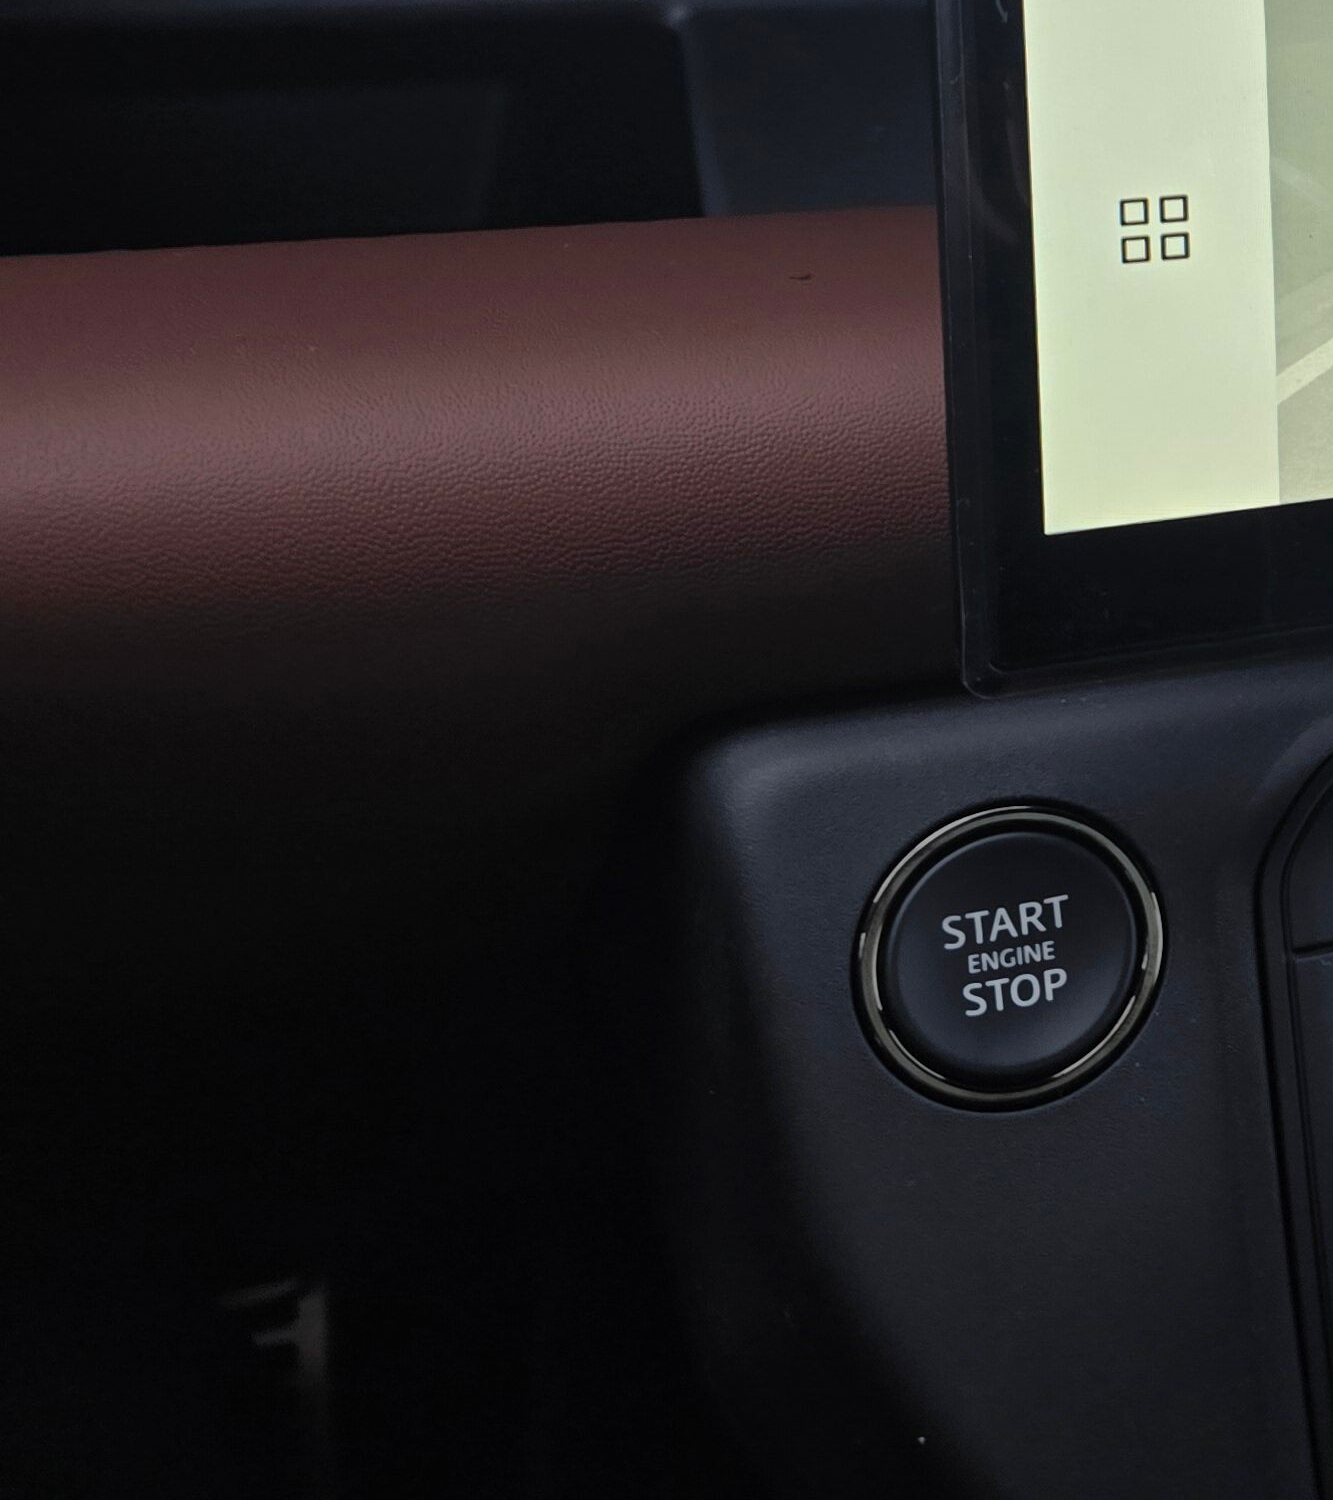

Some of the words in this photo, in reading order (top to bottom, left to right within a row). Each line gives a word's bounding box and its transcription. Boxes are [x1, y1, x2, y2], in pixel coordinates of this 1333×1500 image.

[941, 894, 1069, 950] START
[967, 941, 1055, 974] ENGINE
[963, 968, 1067, 1017] STOP
